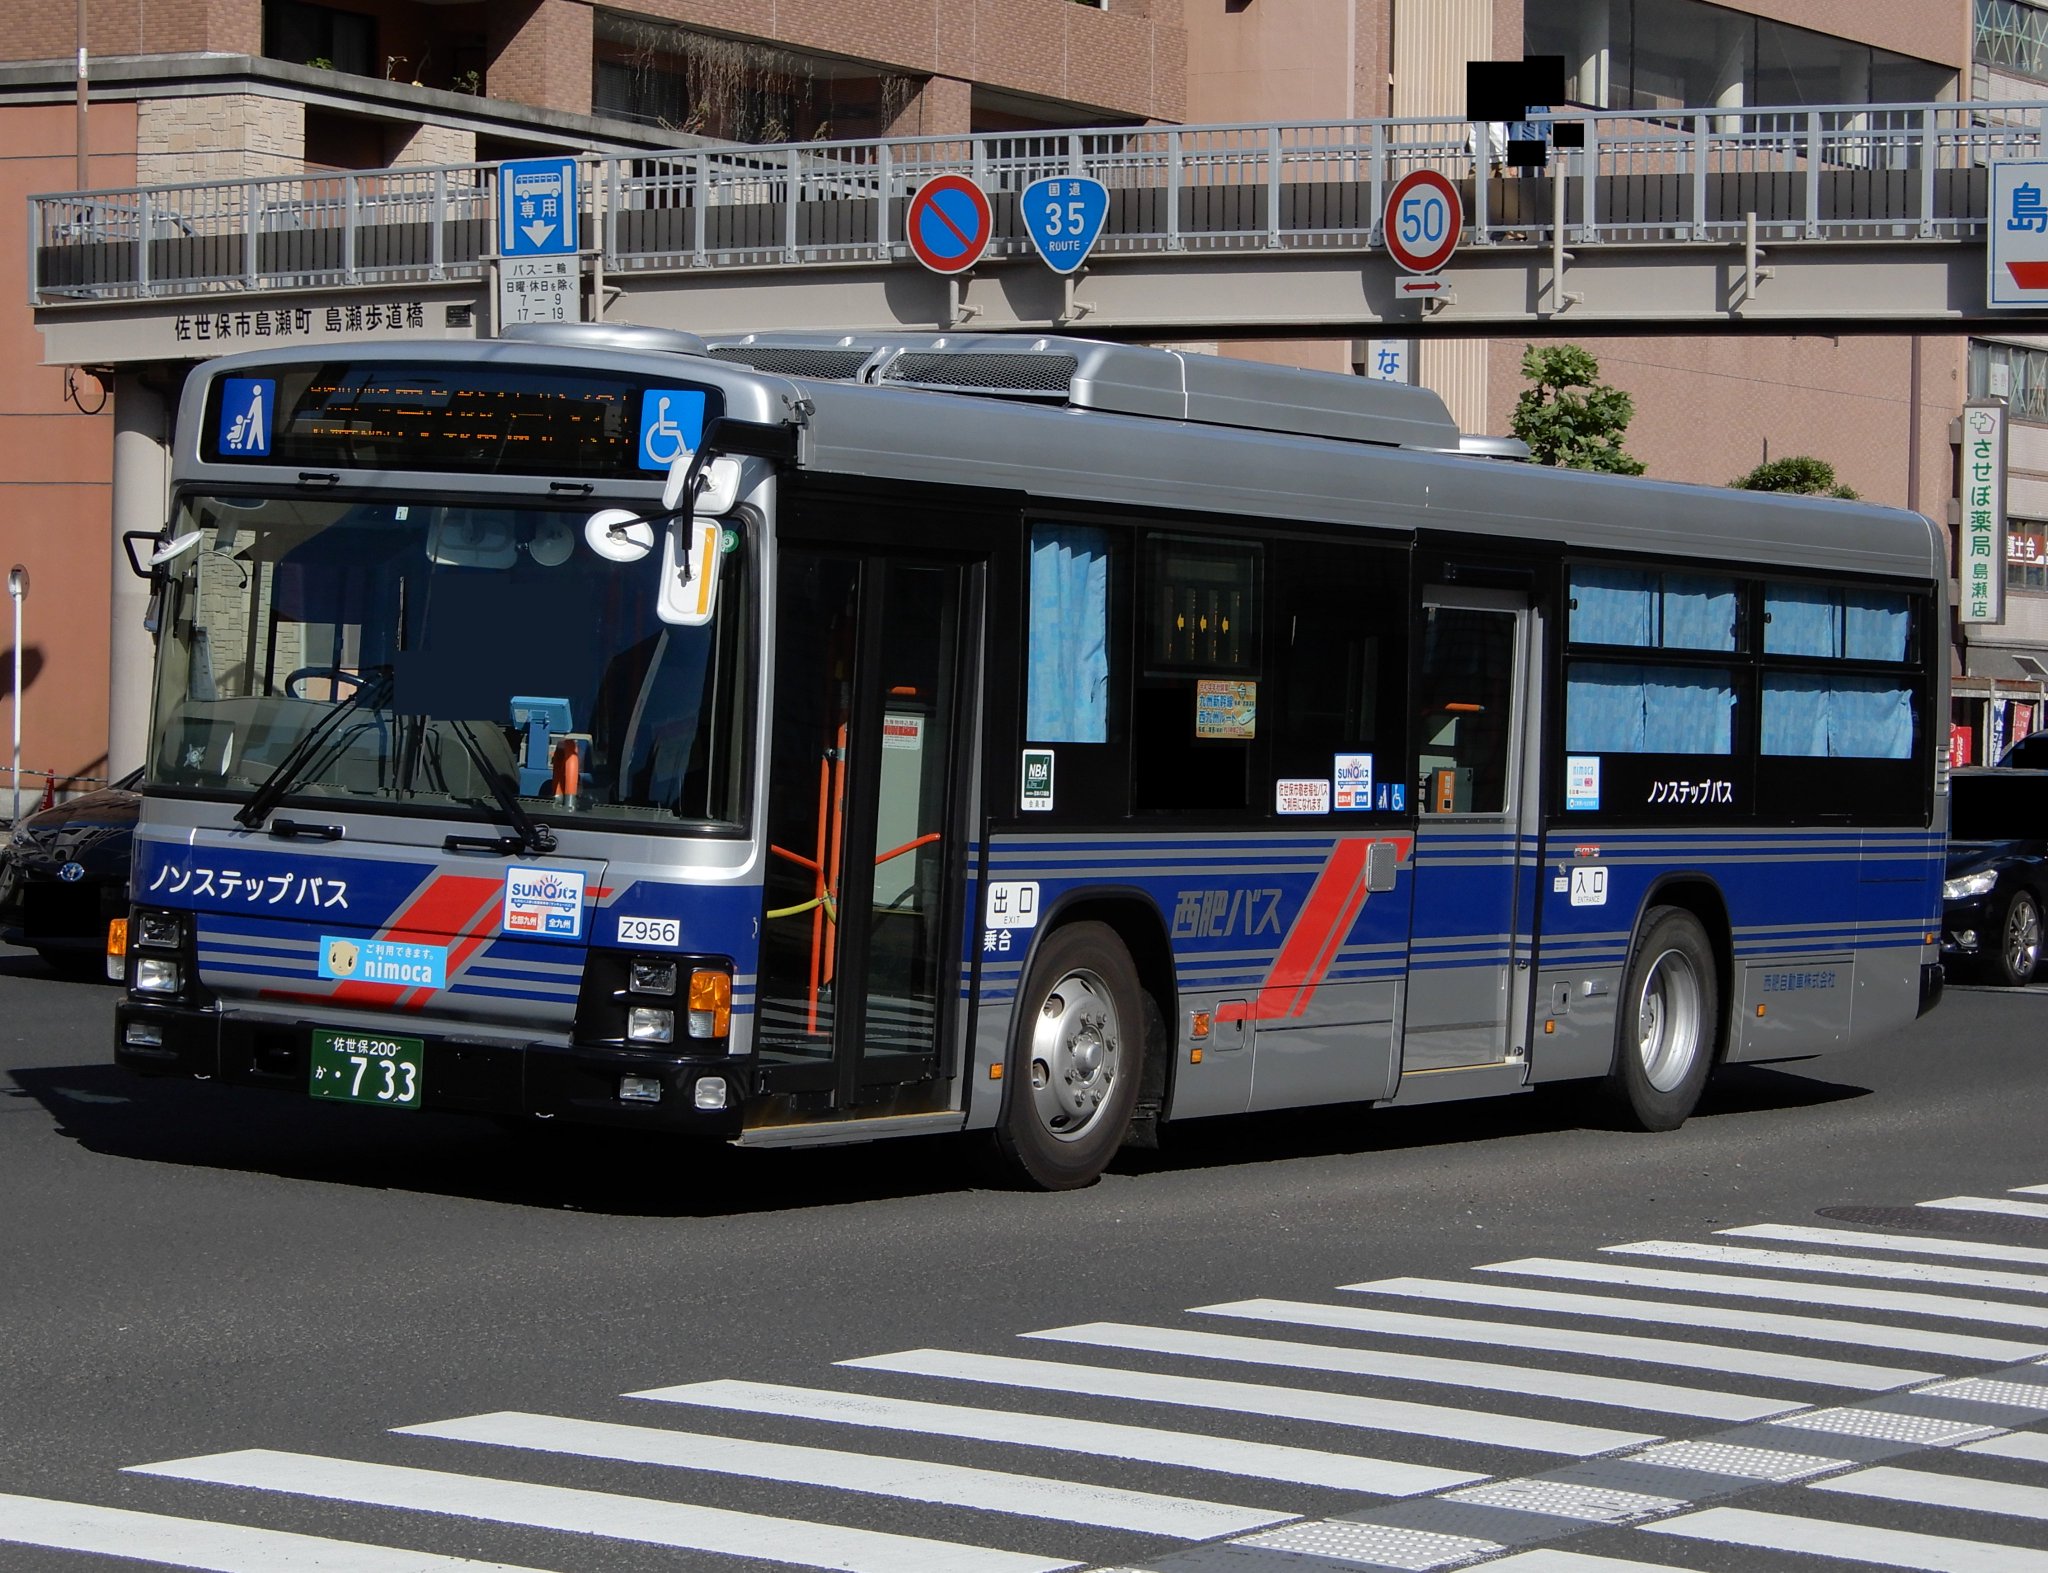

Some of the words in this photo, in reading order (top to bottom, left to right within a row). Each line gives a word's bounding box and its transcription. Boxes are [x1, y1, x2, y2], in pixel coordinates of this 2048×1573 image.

[1048, 182, 1080, 197] 国道
[520, 198, 557, 219] 専用
[1045, 202, 1085, 236] 35
[1402, 198, 1444, 242] 50
[1048, 240, 1081, 252] ROUTE
[506, 279, 574, 293] 日曜・休日を除く
[520, 294, 527, 306] 7
[554, 293, 562, 306] 9
[174, 308, 312, 341] 佐世保市島瀬町
[324, 302, 424, 333] 島瀬歩道橋
[517, 309, 529, 321] 17
[552, 307, 564, 320] 19
[1970, 438, 1993, 558] させぼ薬局
[1971, 562, 1989, 618] 島瀬店
[1028, 763, 1048, 778] NBA
[1647, 779, 1733, 804] ノンステップバス
[150, 865, 348, 909] ノンステップバス
[1576, 871, 1604, 893] 入口
[993, 887, 1033, 914] 出口
[1577, 895, 1600, 904] ENTRANCE
[548, 918, 571, 930] 全九州
[1003, 915, 1020, 925] EXIT
[1171, 888, 1282, 939] 西肥バス
[621, 920, 676, 942] Z956
[983, 929, 1012, 952] 乗合
[366, 944, 434, 960] ご利用できます。
[365, 956, 433, 983] nimoca
[315, 1065, 327, 1080] か
